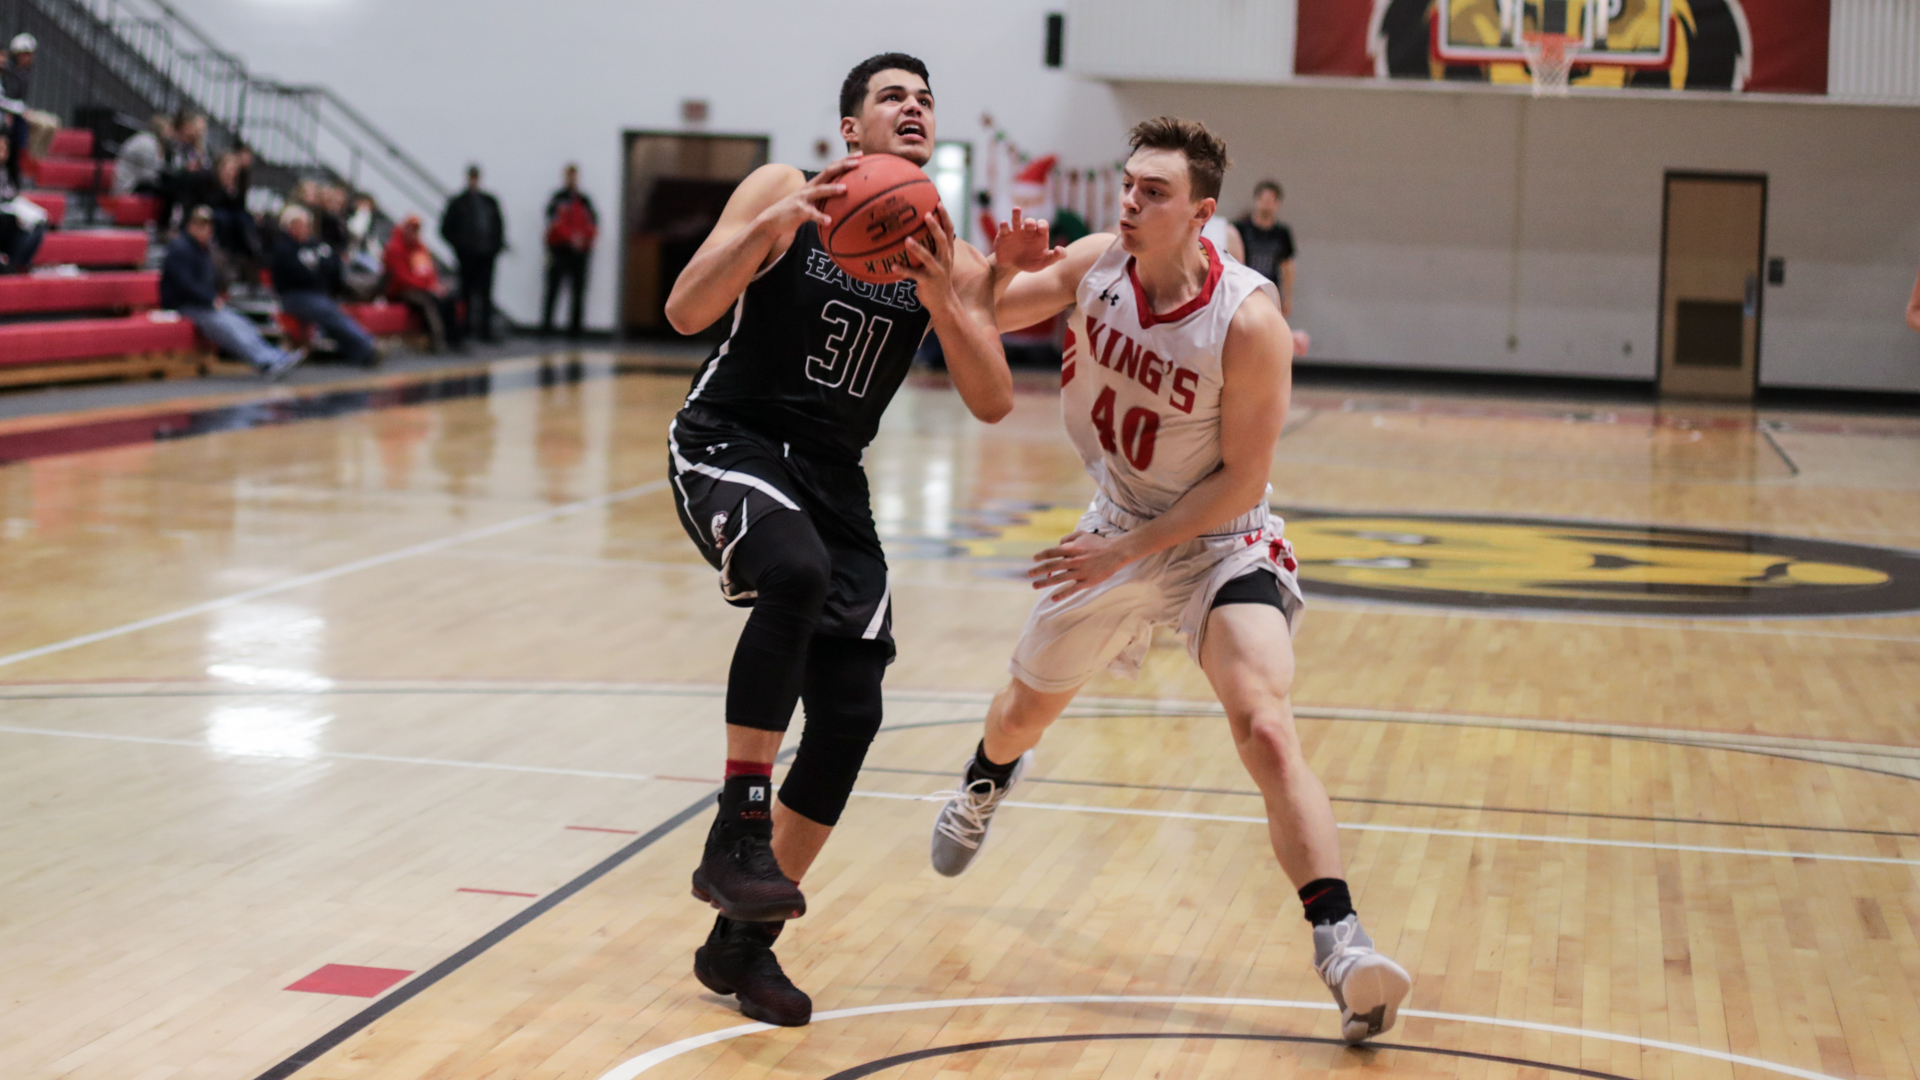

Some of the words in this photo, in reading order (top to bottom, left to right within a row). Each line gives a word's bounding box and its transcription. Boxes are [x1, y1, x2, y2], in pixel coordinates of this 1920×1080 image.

[805, 299, 893, 398] 31
[1086, 315, 1199, 415] KING'S
[1091, 385, 1160, 471] 40
